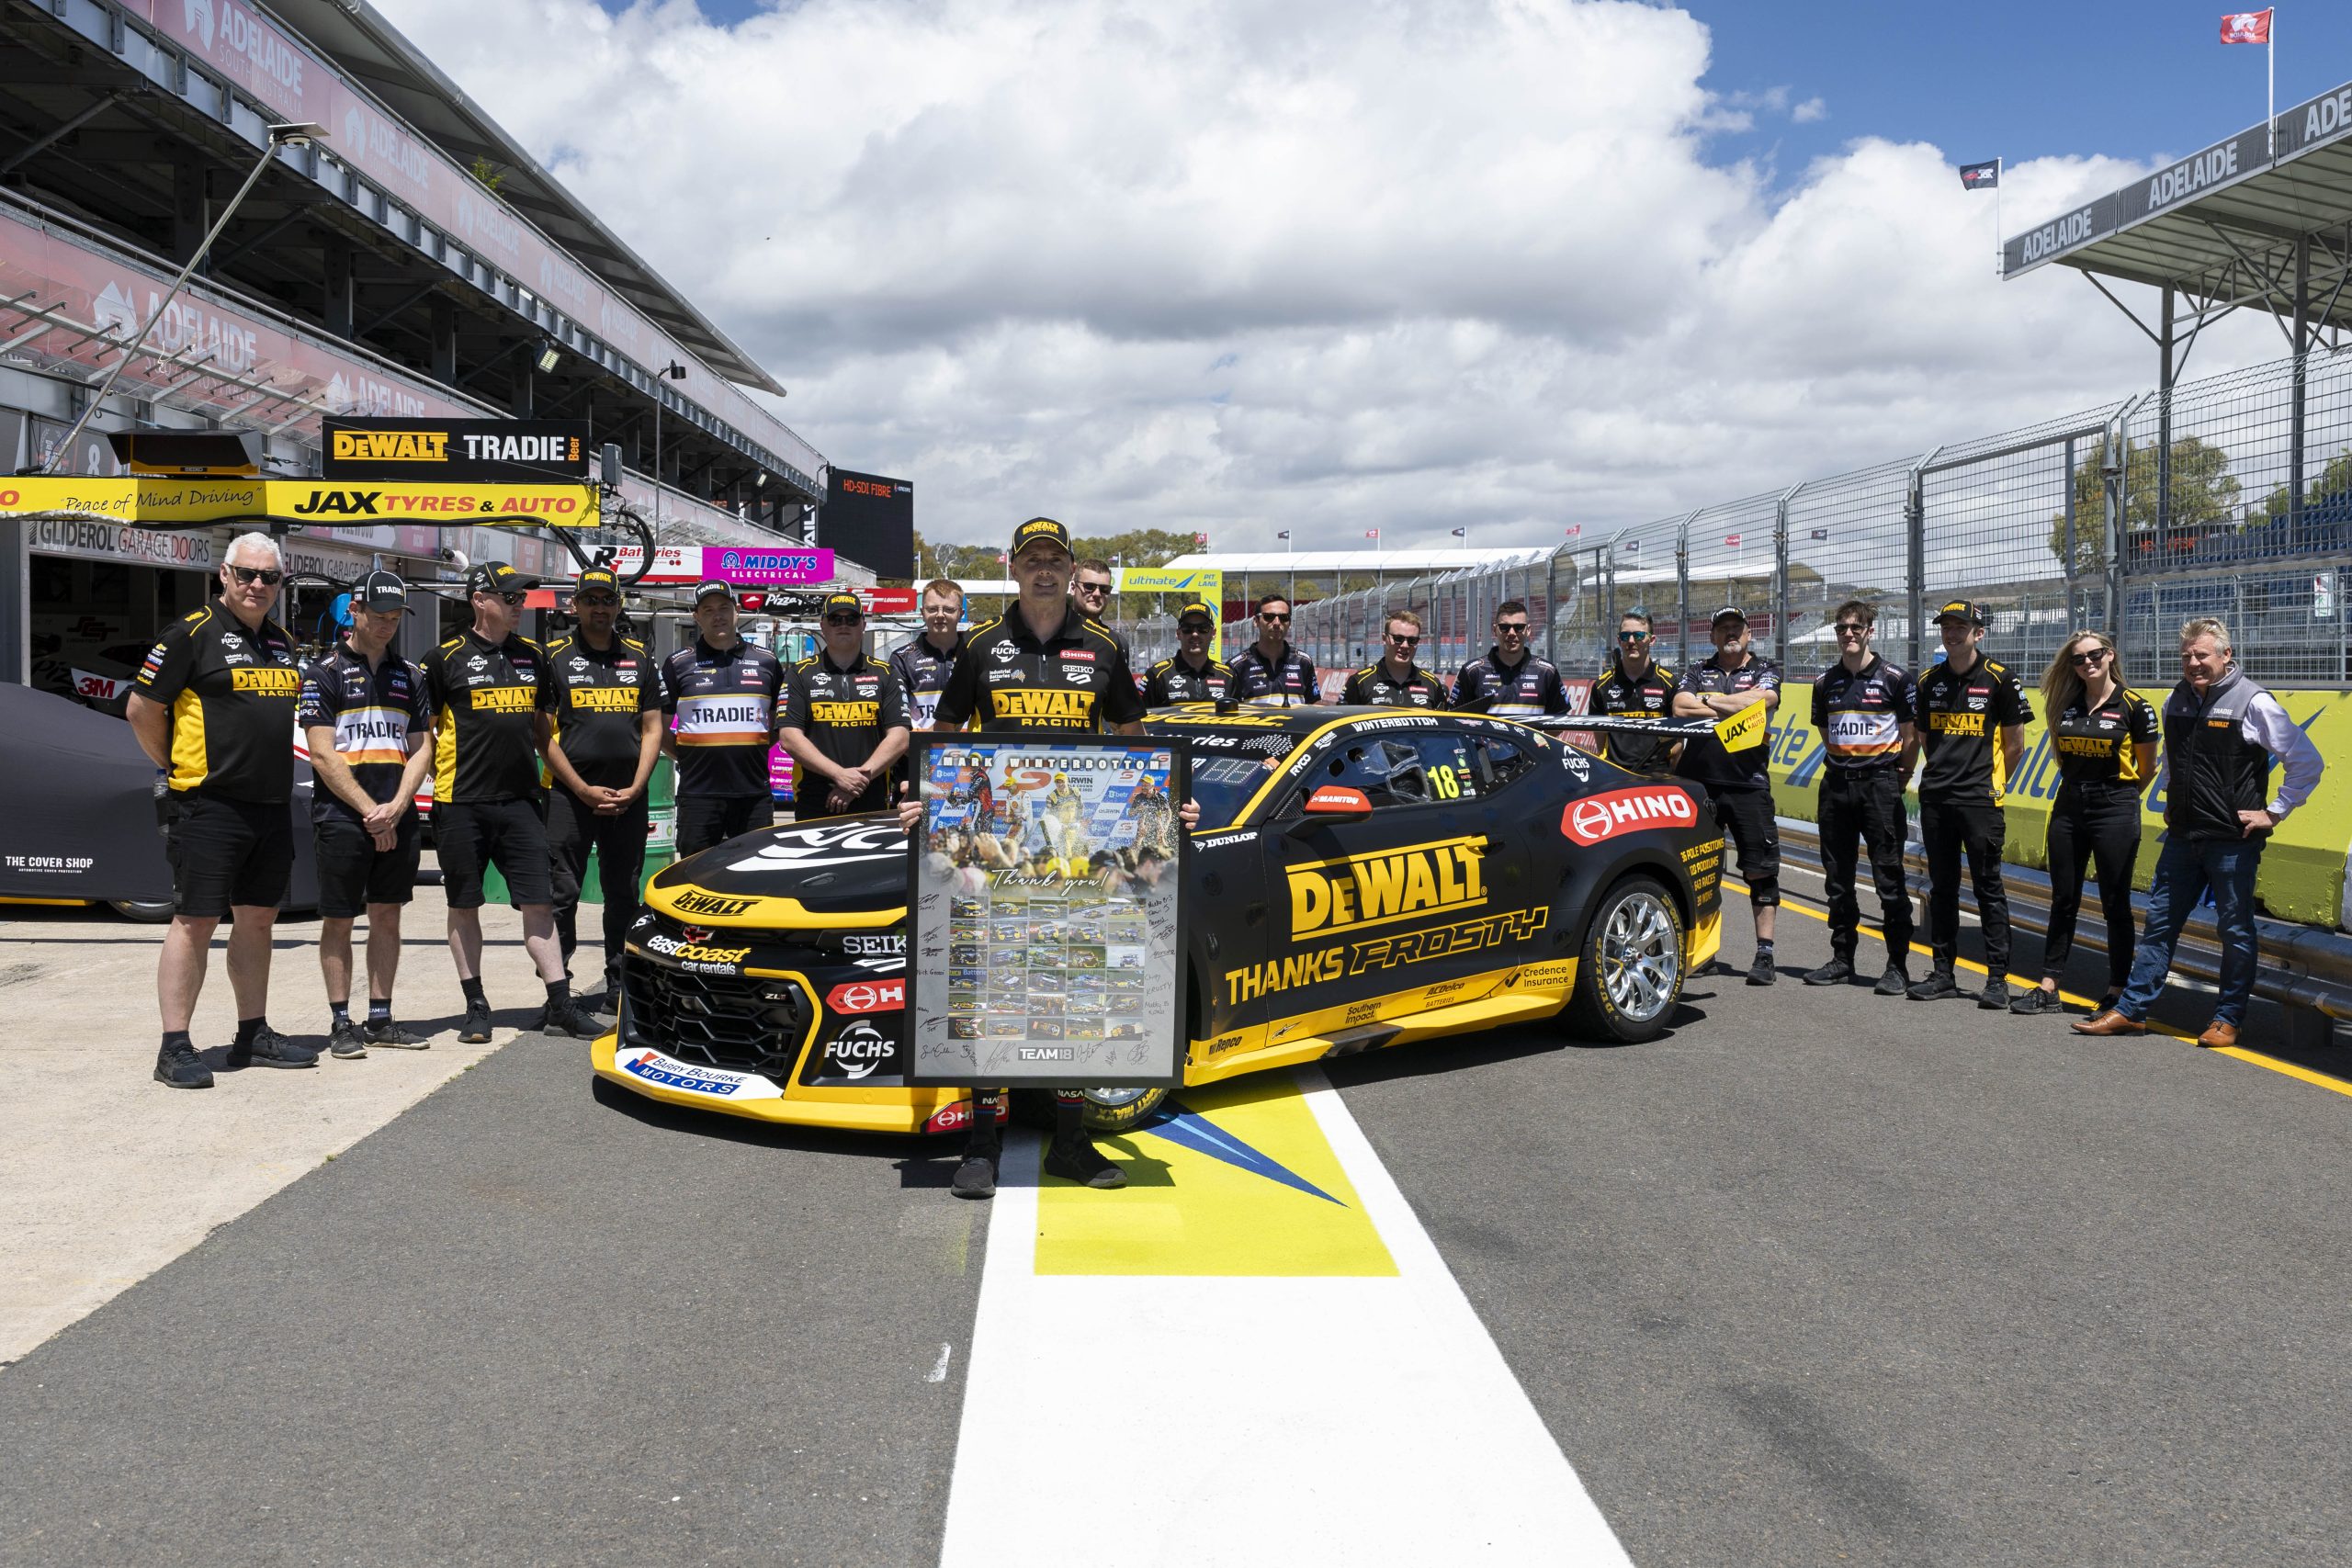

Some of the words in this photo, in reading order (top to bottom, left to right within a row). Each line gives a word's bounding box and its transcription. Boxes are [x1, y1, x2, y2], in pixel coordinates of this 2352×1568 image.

[220, 1, 303, 96] ADELAIDE
[220, 44, 252, 83] SOUTH
[368, 118, 429, 190] ADELAIDE
[2150, 141, 2237, 210] ADELAIDE
[2022, 209, 2092, 265] ADELAIDE
[146, 290, 256, 375] ADELAIDE
[463, 434, 565, 461] TRADIE
[568, 436, 580, 461] Beer
[843, 479, 870, 495] HD-SDI
[871, 483, 891, 498] FIBRE
[113, 493, 133, 513] of
[135, 491, 184, 508] Mind
[294, 491, 382, 514] JAX
[384, 495, 476, 513] TYRES
[480, 501, 495, 513] &
[501, 497, 577, 513] AUTO
[40, 521, 115, 552] GLIDEROL
[118, 528, 169, 558] GARAGE
[171, 535, 209, 563] DOORS
[327, 559, 358, 582] GARAGE
[743, 556, 818, 570] MIDDY'S
[731, 570, 807, 579] ELECTRICAL
[1129, 576, 1176, 585] ultimate
[376, 586, 402, 594] TRADIE
[697, 584, 720, 595] TRADIE
[221, 637, 243, 645] FUCHS
[991, 647, 1021, 655] FUCHS
[468, 659, 489, 668] FUCHS
[1062, 665, 1094, 673] SEIKO
[78, 676, 116, 699] 3M
[992, 691, 1094, 715] DEWALT
[692, 706, 754, 724] TRADIE
[1021, 717, 1091, 728] RACING
[1746, 710, 1763, 725] TYRES
[1751, 716, 1765, 729] AUTO
[345, 721, 401, 741] TRADIE
[1351, 716, 1439, 732] WINTERBOTTOM
[1596, 721, 1645, 730] TRUCK
[1646, 725, 1714, 734] WASHING
[1724, 719, 1748, 744] JAX
[943, 757, 993, 767] MARK
[1009, 758, 1160, 770] WINTERBOTTOM
[1290, 753, 1311, 777] RYCO
[1562, 757, 1591, 771] FUCHS
[1428, 765, 1460, 799] 18
[1318, 795, 1359, 806] MANITOU
[1609, 794, 1691, 824] HINO
[1206, 831, 1258, 848] DUNLOP
[6, 855, 26, 867] THE
[28, 856, 63, 868] COVER
[65, 857, 94, 868] SHOP
[1687, 846, 1700, 860] POLE
[1697, 855, 1719, 874] PODIUMS
[991, 868, 1056, 891] Thank
[1061, 871, 1109, 897] you!
[1702, 872, 1716, 888] RACES
[1286, 843, 1486, 935] DEWALT
[647, 934, 752, 964] eastcoast
[842, 935, 907, 955] SEIK
[1225, 946, 1344, 1006] THANKS
[1349, 906, 1549, 976] FROSTY
[681, 960, 697, 972] car
[699, 962, 736, 976] rentals
[1523, 964, 1567, 977] Credence
[1426, 982, 1465, 997] ACDelco
[1523, 975, 1569, 987] Insurance
[1347, 1001, 1382, 1016] Southern
[1425, 996, 1454, 1009] BATTERIES
[824, 1040, 895, 1059] FUCHS
[1217, 1036, 1242, 1053] Repco
[652, 1056, 684, 1074] BARRY
[685, 1066, 748, 1085] BOURKE
[640, 1067, 741, 1095] MOTORS
[1057, 1089, 1084, 1098] NASA
